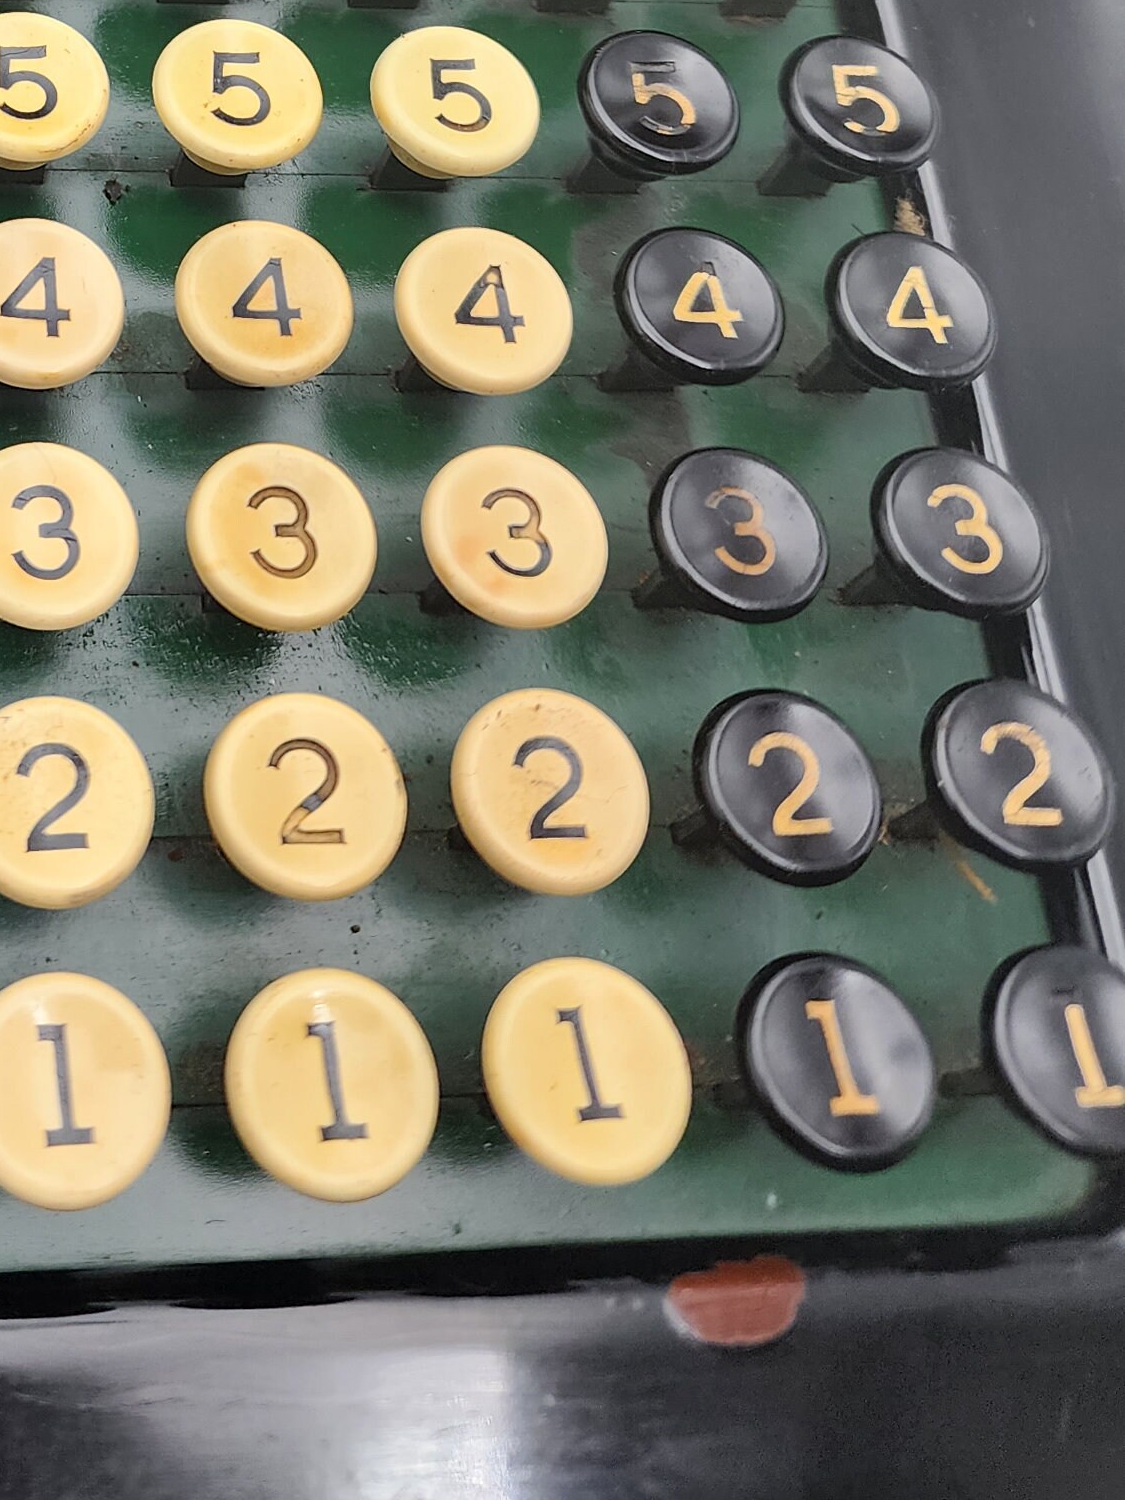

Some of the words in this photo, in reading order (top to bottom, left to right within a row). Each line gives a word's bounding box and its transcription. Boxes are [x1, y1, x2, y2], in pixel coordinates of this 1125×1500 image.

[212, 51, 271, 126] 5
[429, 58, 492, 132] 5
[632, 60, 696, 135] 5
[832, 64, 901, 133] 5
[0, 256, 71, 338] 4
[232, 256, 301, 337] 4
[455, 264, 525, 344] 4
[673, 261, 743, 338] 4
[886, 266, 953, 344] 4
[11, 484, 80, 580] 3
[248, 486, 317, 579] 3
[482, 488, 553, 577] 3
[705, 484, 775, 576] 3
[927, 483, 1003, 575] 3
[17, 742, 91, 852] 2
[268, 738, 347, 844] 2
[512, 736, 589, 840] 2
[748, 731, 833, 836] 2
[981, 721, 1063, 826] 2
[38, 1024, 95, 1146] 1
[307, 1021, 369, 1141] 1
[556, 1006, 625, 1122] 1
[805, 999, 880, 1116] 1
[1064, 1002, 1125, 1107] 1
